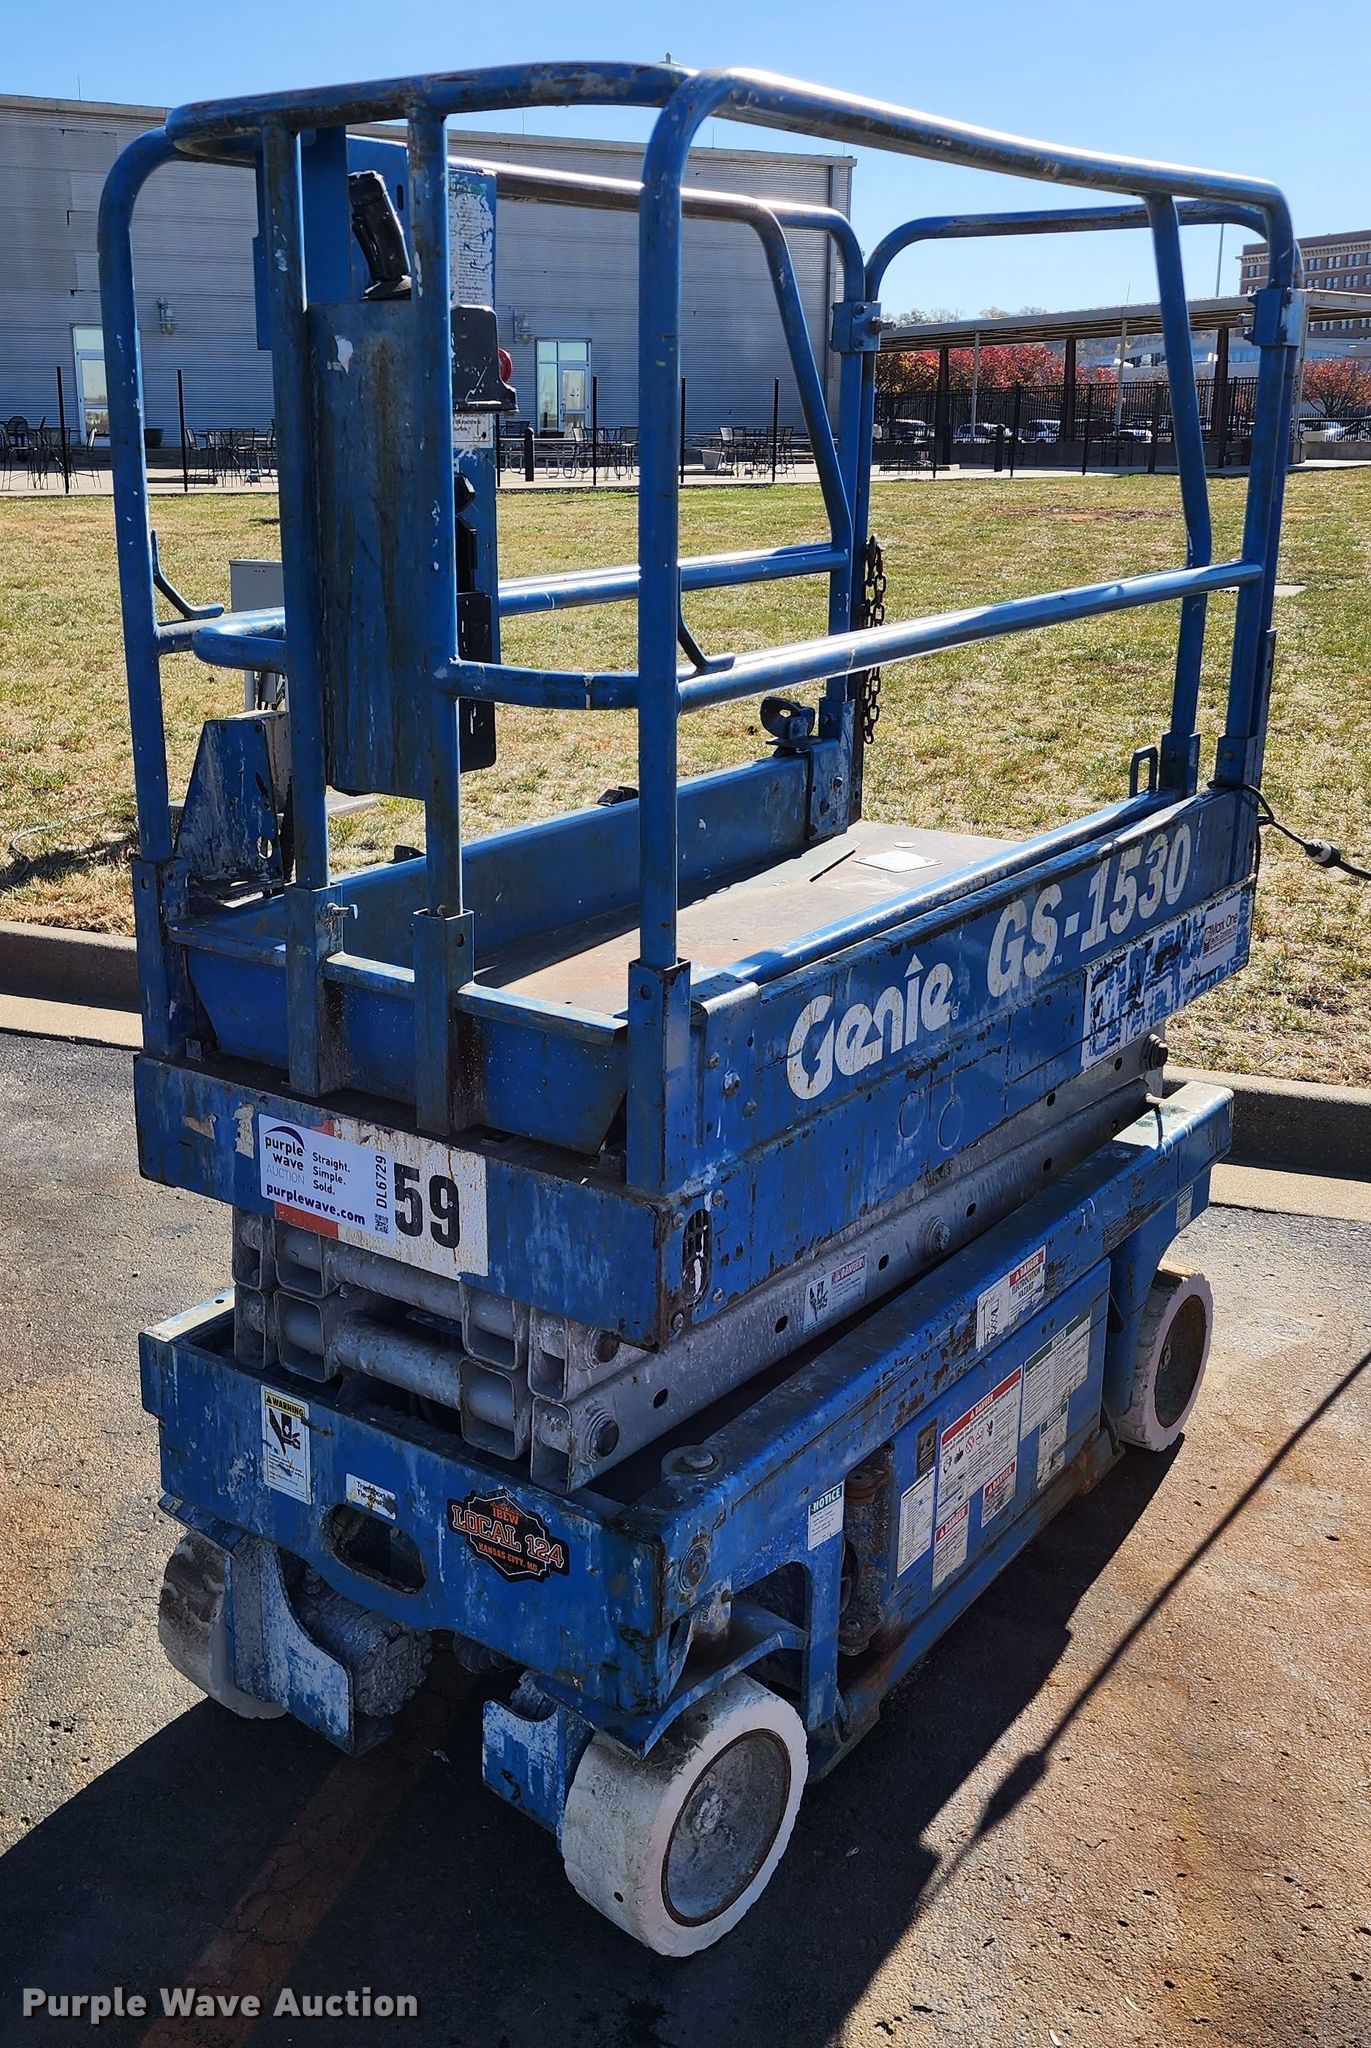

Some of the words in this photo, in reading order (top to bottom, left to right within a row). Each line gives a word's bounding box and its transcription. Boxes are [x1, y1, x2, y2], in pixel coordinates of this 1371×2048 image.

[787, 953, 954, 1100] Genie
[987, 823, 1191, 998] GS-1530
[265, 1136, 304, 1157] purple
[273, 1153, 304, 1171] wave
[312, 1152, 350, 1173] Straight.
[266, 1164, 305, 1185] AUCTION
[312, 1165, 346, 1185] Simple.
[375, 1155, 388, 1209] DL6729
[313, 1180, 336, 1195] Sold.
[266, 1183, 366, 1225] purplewave.com
[394, 1162, 461, 1249] 59
[273, 1397, 304, 1416] WARNING
[812, 1487, 841, 1512] NOTICE
[491, 1508, 519, 1526] IBEW
[452, 1504, 522, 1552] LOCAL
[525, 1534, 565, 1568] 124
[478, 1542, 507, 1560] KANSAS
[507, 1555, 526, 1568] CITY,
